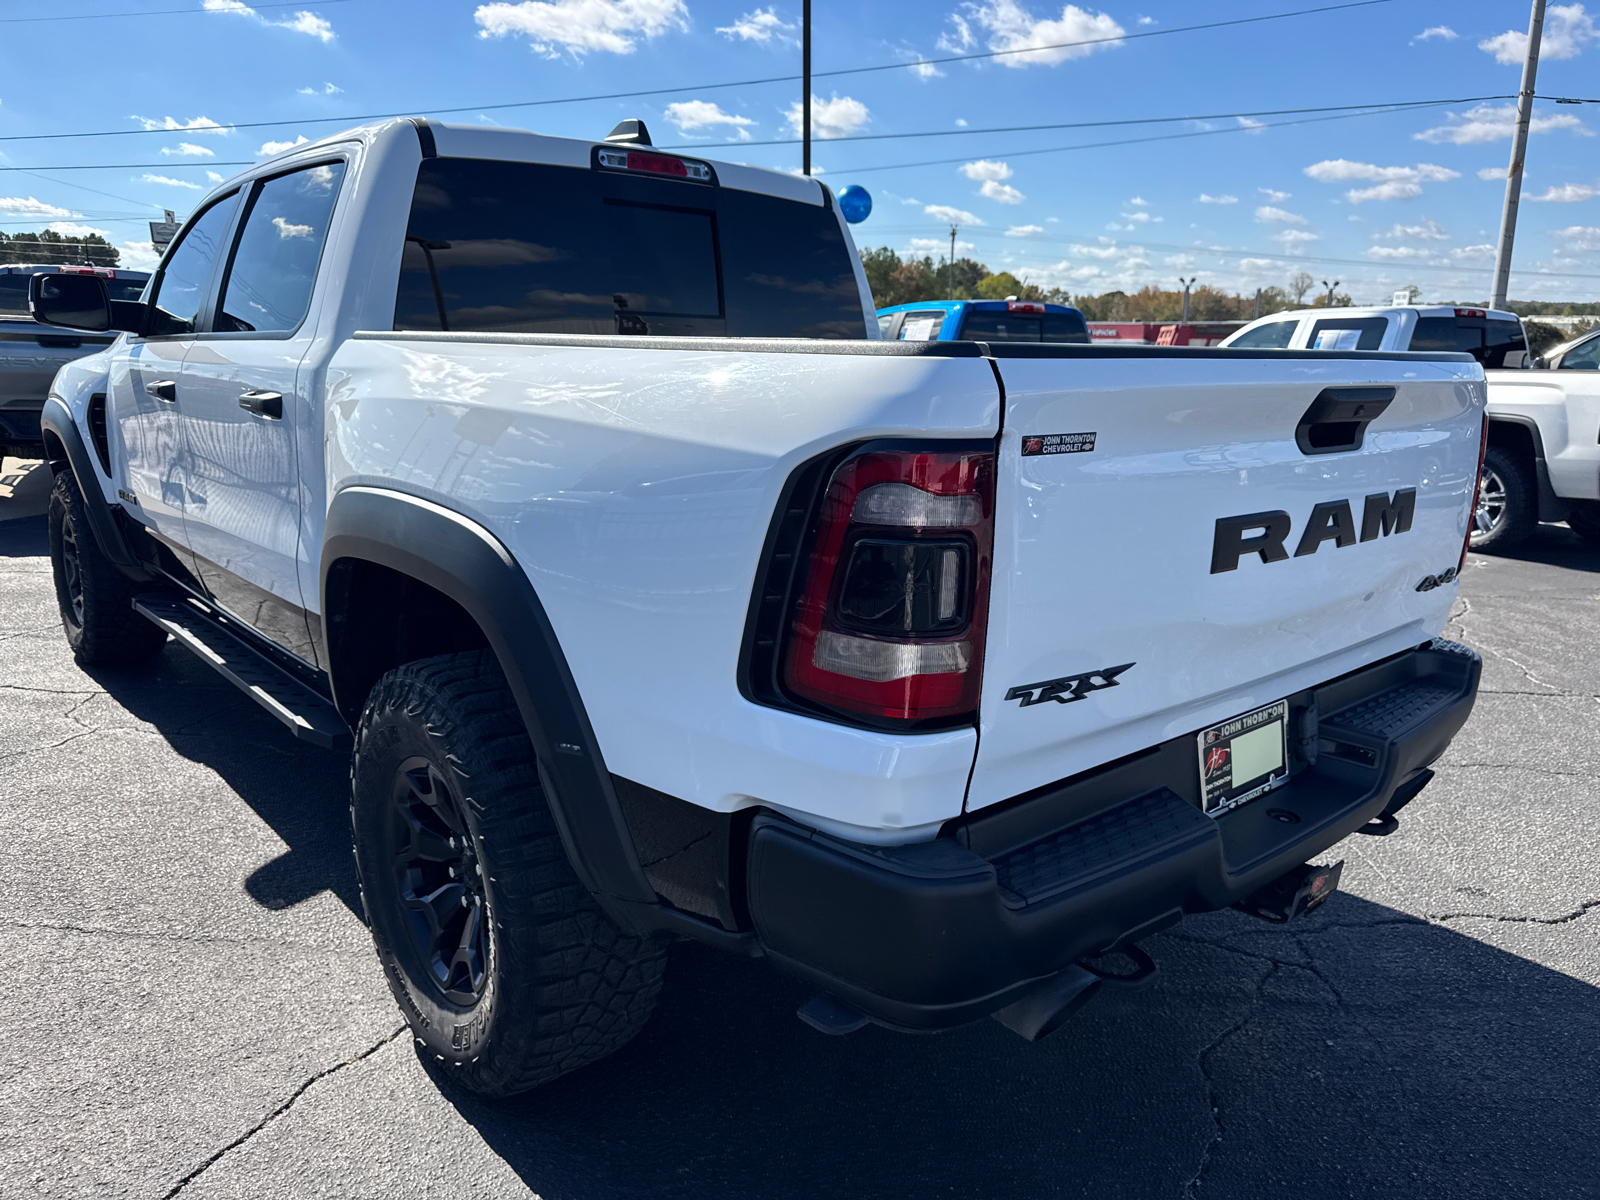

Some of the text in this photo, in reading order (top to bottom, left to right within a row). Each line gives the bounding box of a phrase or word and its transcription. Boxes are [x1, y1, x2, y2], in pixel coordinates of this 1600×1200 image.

[1042, 443, 1082, 453] CHEVROLET
[1043, 434, 1096, 445] JOHN THORNTON
[1210, 486, 1417, 574] RAM
[1004, 661, 1137, 707] TRX
[1221, 720, 1242, 737] JOHN
